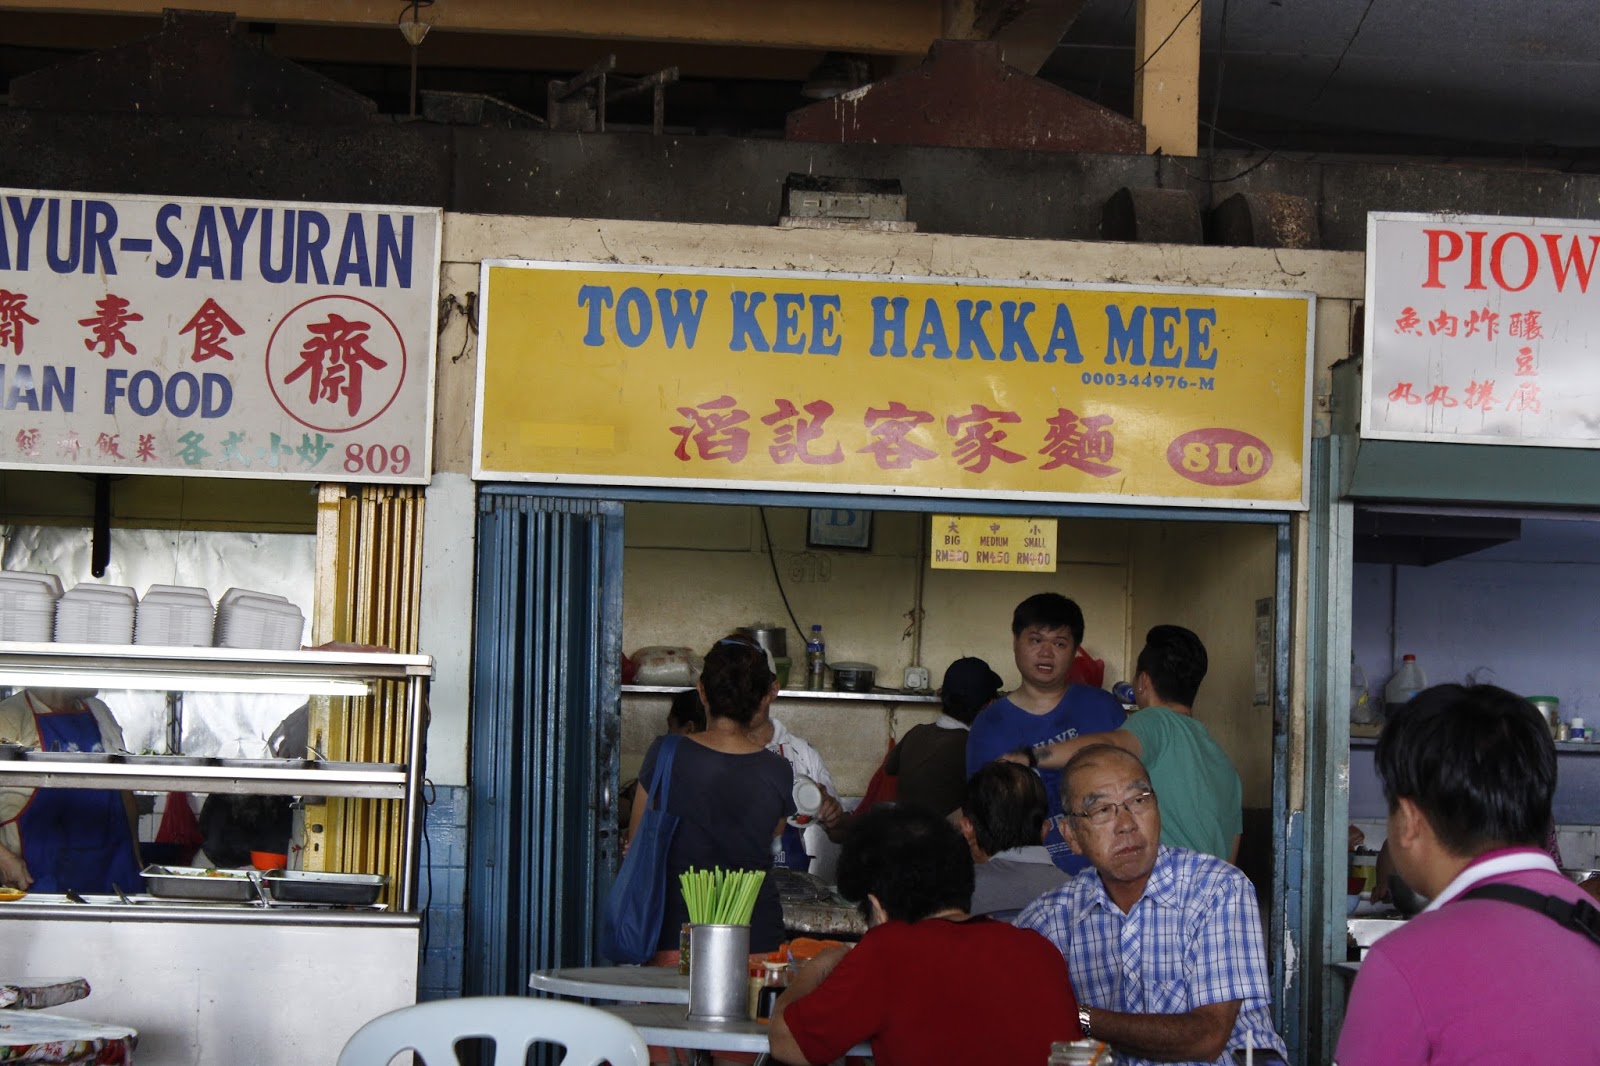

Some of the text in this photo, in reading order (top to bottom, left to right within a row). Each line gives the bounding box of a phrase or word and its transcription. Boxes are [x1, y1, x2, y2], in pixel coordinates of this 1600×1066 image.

[0, 196, 414, 289] YUR-SAYURAN
[1421, 229, 1600, 294] PIOW
[577, 284, 1218, 370] TOW KEE HAKKA MEE
[105, 368, 233, 419] FOOD
[1080, 371, 1215, 391] 000344976-M
[669, 394, 1123, 479] 滔記客家麵
[343, 443, 411, 475] 809
[1181, 442, 1264, 475] 810
[944, 535, 1047, 548] BIG MEDIUM SMALL
[989, 522, 1001, 535] 中
[1029, 525, 1041, 535] 小
